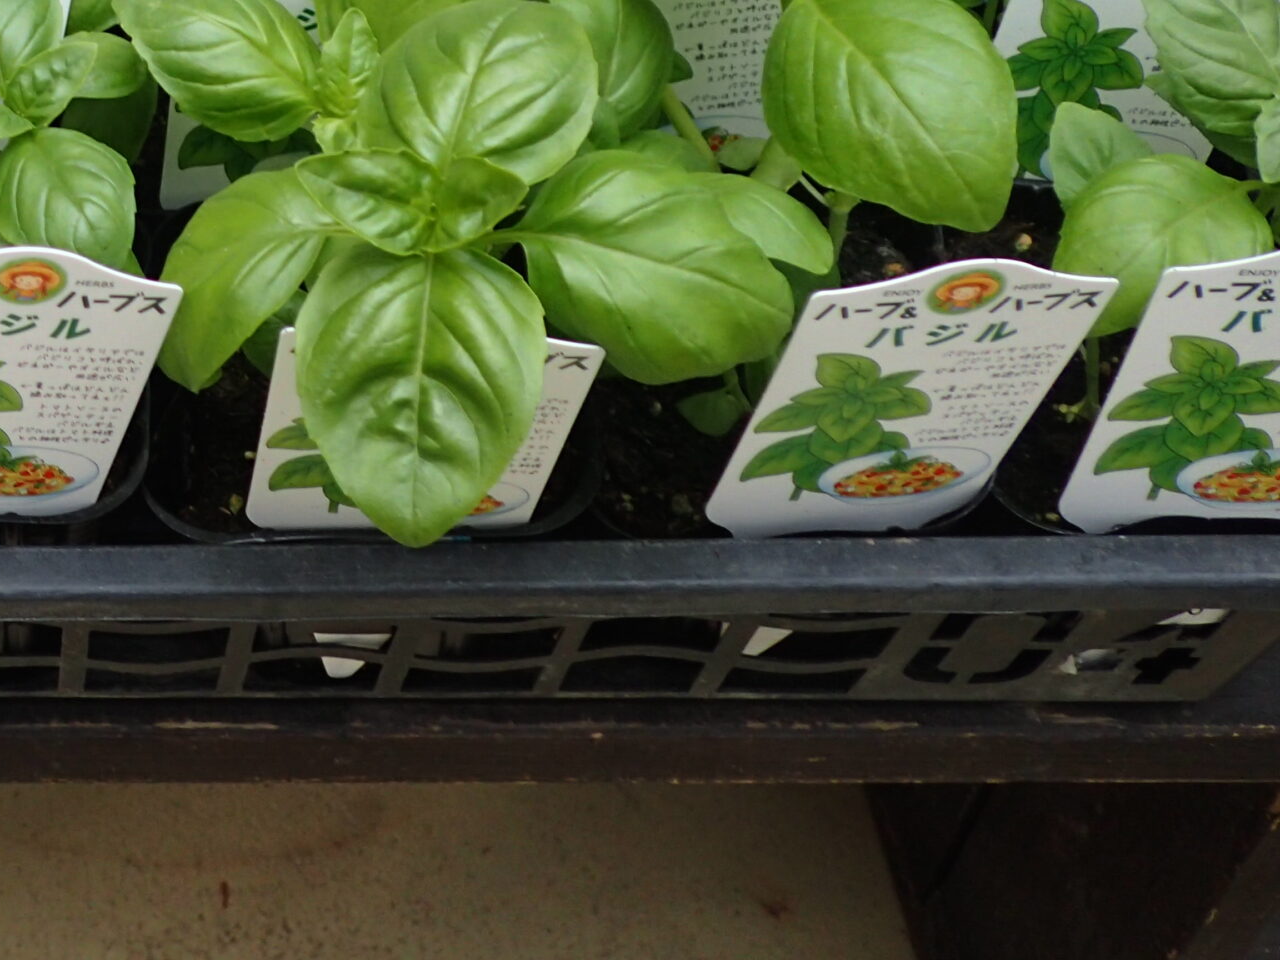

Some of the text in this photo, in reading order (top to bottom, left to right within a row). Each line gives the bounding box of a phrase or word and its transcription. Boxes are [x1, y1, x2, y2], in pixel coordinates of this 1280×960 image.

[74, 279, 115, 289] HERBS
[883, 283, 1052, 296] ENJOY HERBS
[57, 291, 168, 315] ハーブス
[988, 289, 1103, 313] ハーブス
[865, 321, 1018, 348] バジル
